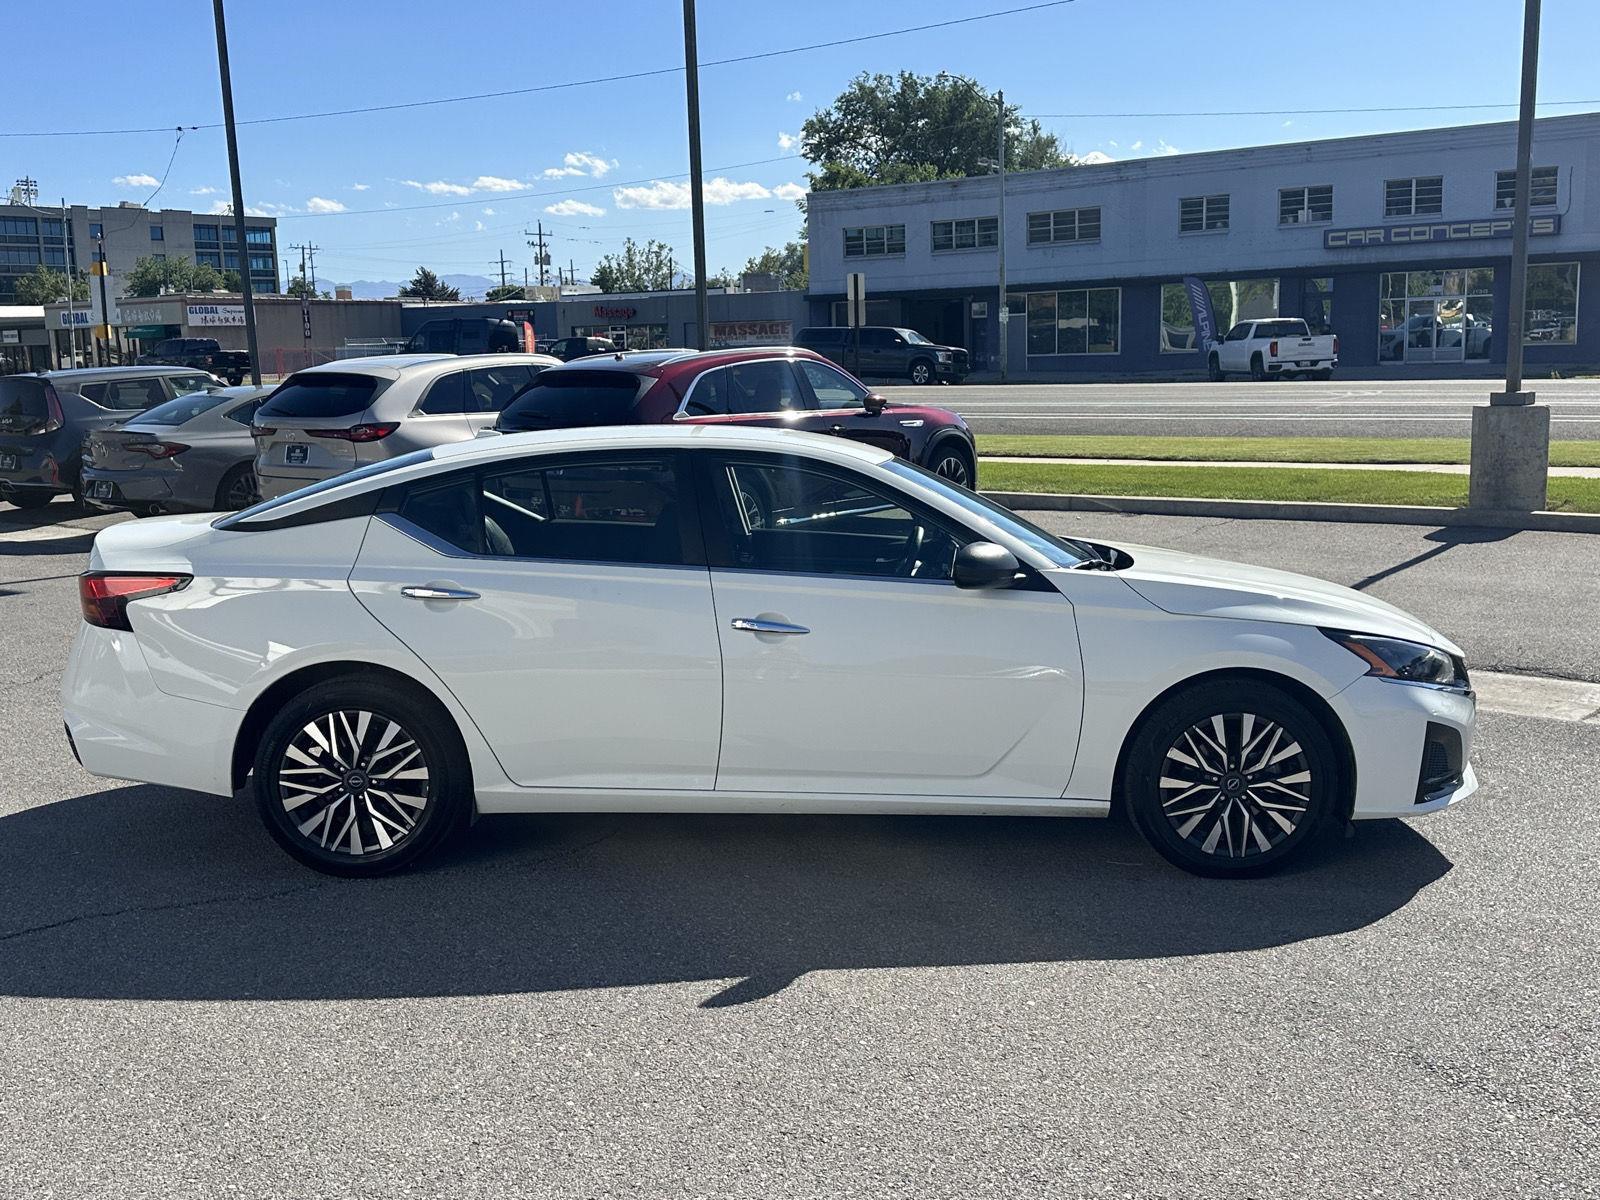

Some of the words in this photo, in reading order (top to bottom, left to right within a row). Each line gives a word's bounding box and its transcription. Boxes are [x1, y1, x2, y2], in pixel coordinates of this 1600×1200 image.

[1328, 229, 1384, 246] CAR
[1391, 218, 1554, 242] CONCEPS
[189, 306, 219, 315] GLOBAL
[714, 323, 789, 336] MASSAGE
[1196, 305, 1213, 352] ALPINE
